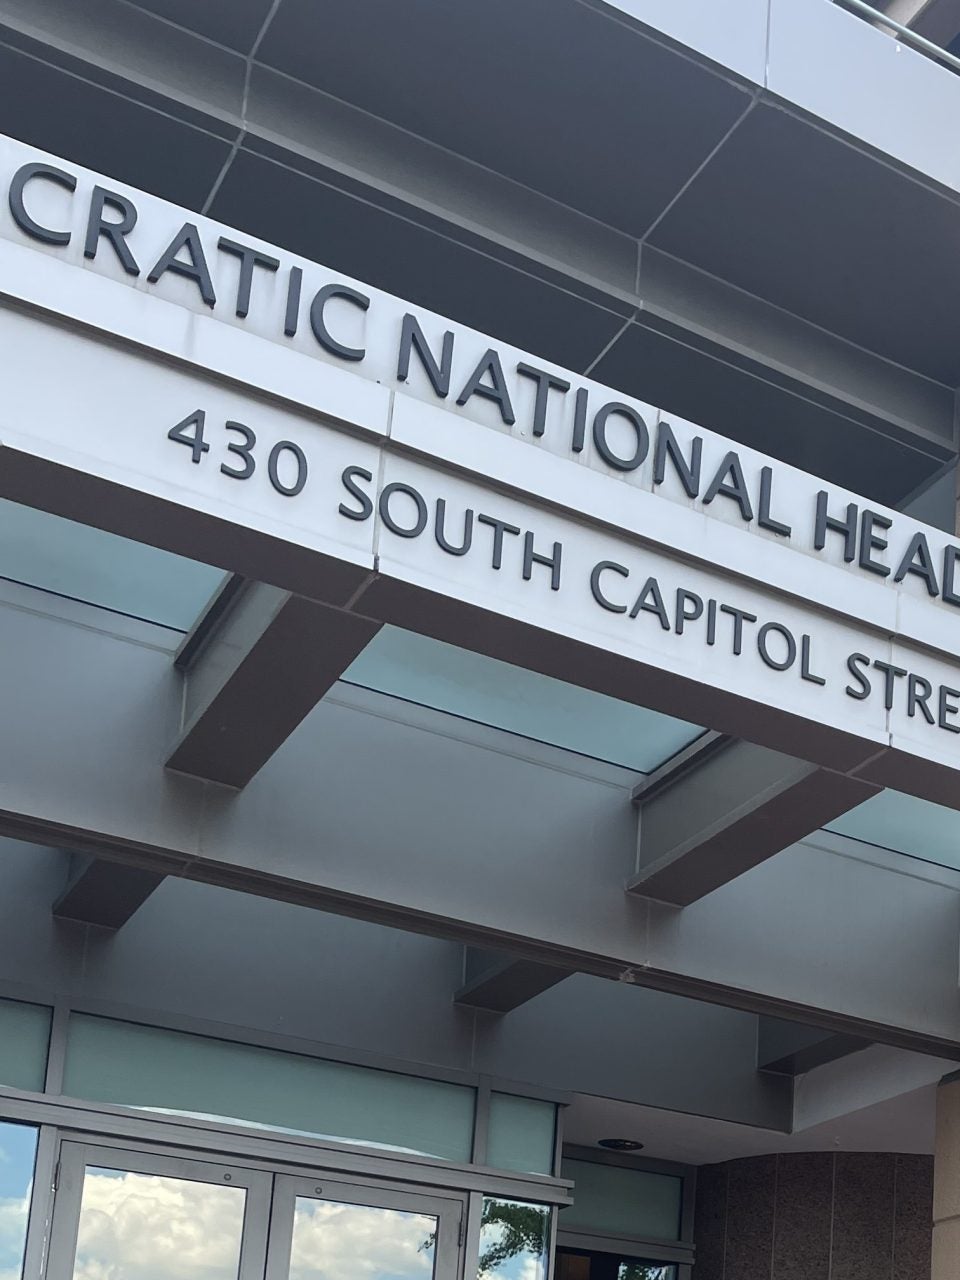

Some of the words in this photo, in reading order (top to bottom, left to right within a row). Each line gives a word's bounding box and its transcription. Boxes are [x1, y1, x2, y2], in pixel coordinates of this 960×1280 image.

[8, 162, 370, 361] CRATIC
[397, 313, 791, 537] NATIONAL
[167, 409, 308, 496] 430
[338, 466, 562, 590] SOUTH
[590, 561, 825, 686] CAPITOL
